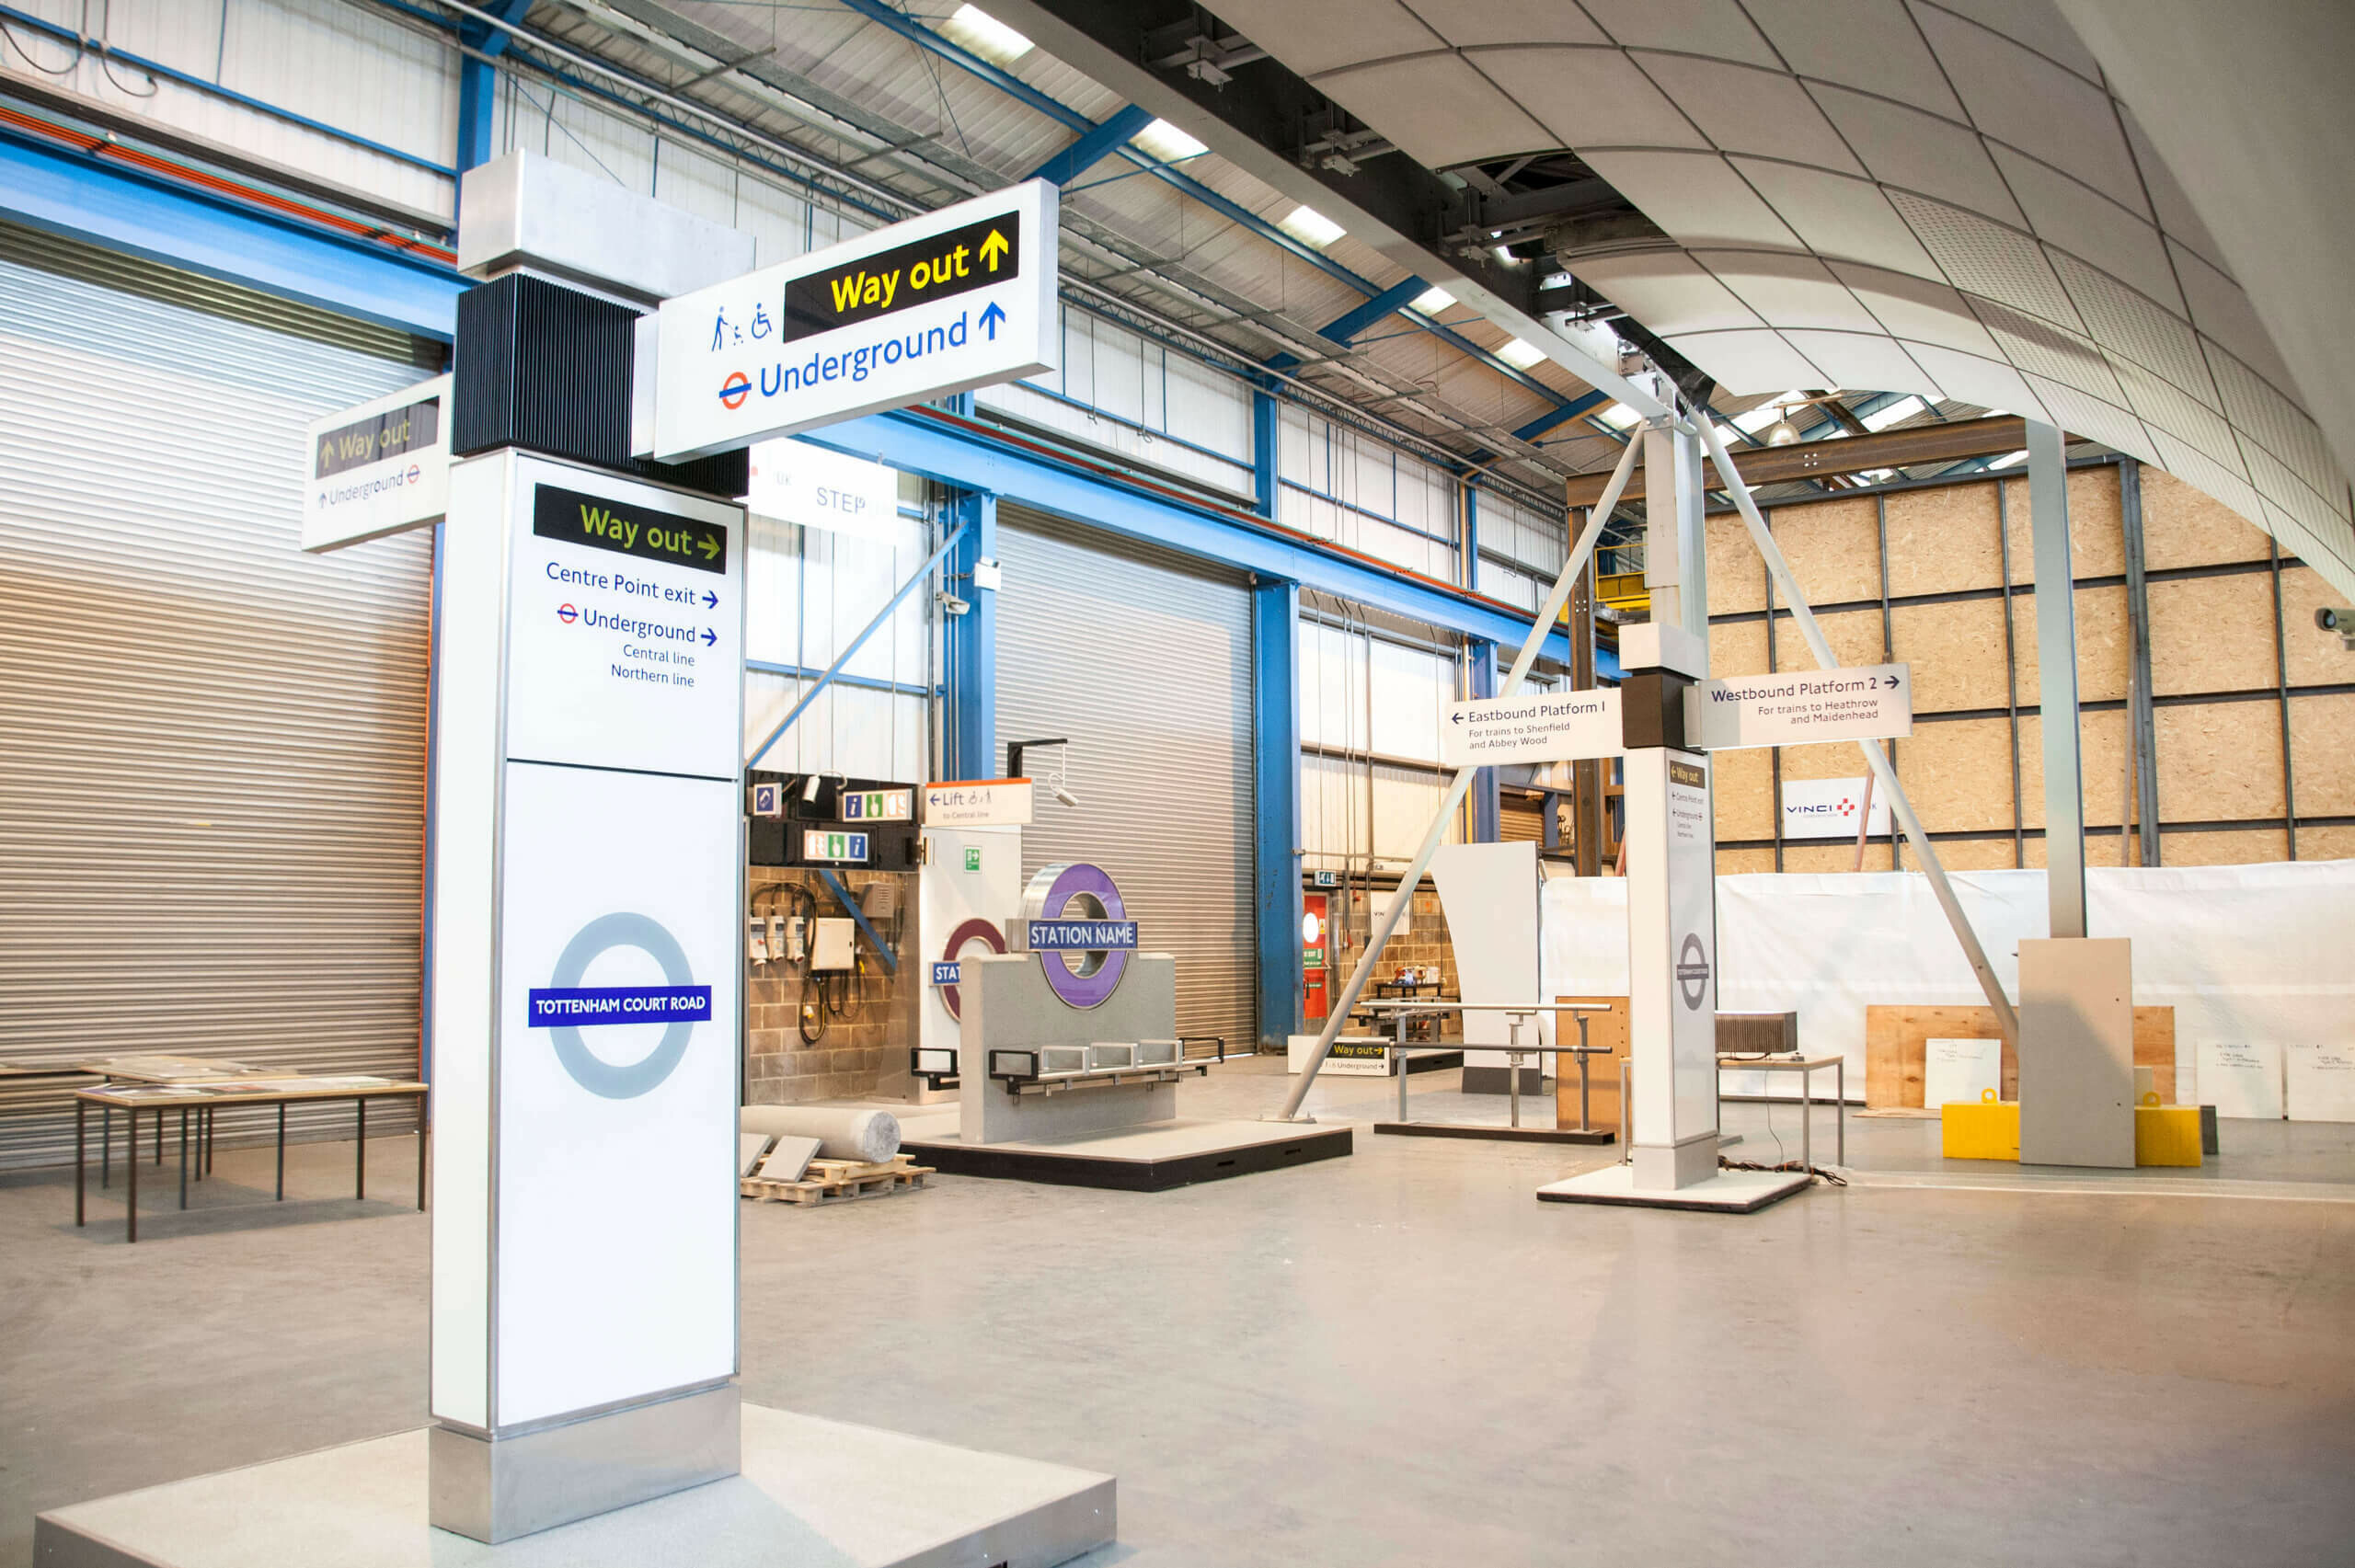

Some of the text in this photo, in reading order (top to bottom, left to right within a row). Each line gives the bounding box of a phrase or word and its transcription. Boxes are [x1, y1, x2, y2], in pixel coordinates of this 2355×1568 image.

[831, 245, 970, 313] Way out
[760, 311, 968, 396] Underground
[339, 419, 411, 461] Way out
[329, 469, 404, 505] Underground
[580, 503, 693, 555] Way out
[546, 562, 696, 605] Centre Point exit
[583, 608, 695, 643] Underground
[623, 644, 695, 667] Central line
[611, 664, 695, 688] Northern line
[1711, 677, 1878, 703] Westbound Platform 2
[1468, 706, 1536, 723] Eastbound
[1540, 703, 1598, 717] Platform
[1758, 699, 1878, 715] For trains to Heathrow
[1790, 710, 1878, 725] and Maidenhead
[1468, 722, 1570, 738] For trains to Shenfield
[1469, 736, 1547, 750] and Abbey Wood
[1676, 765, 1699, 784] Way out
[943, 793, 964, 806] Lift
[1786, 805, 1832, 813] VINCI
[1031, 926, 1134, 944] STATION NAME
[936, 967, 960, 980] STAT
[536, 996, 706, 1015] TOTTENHAM COURT ROAD
[1334, 1045, 1373, 1056] Way out
[1337, 1061, 1378, 1070] Underground
